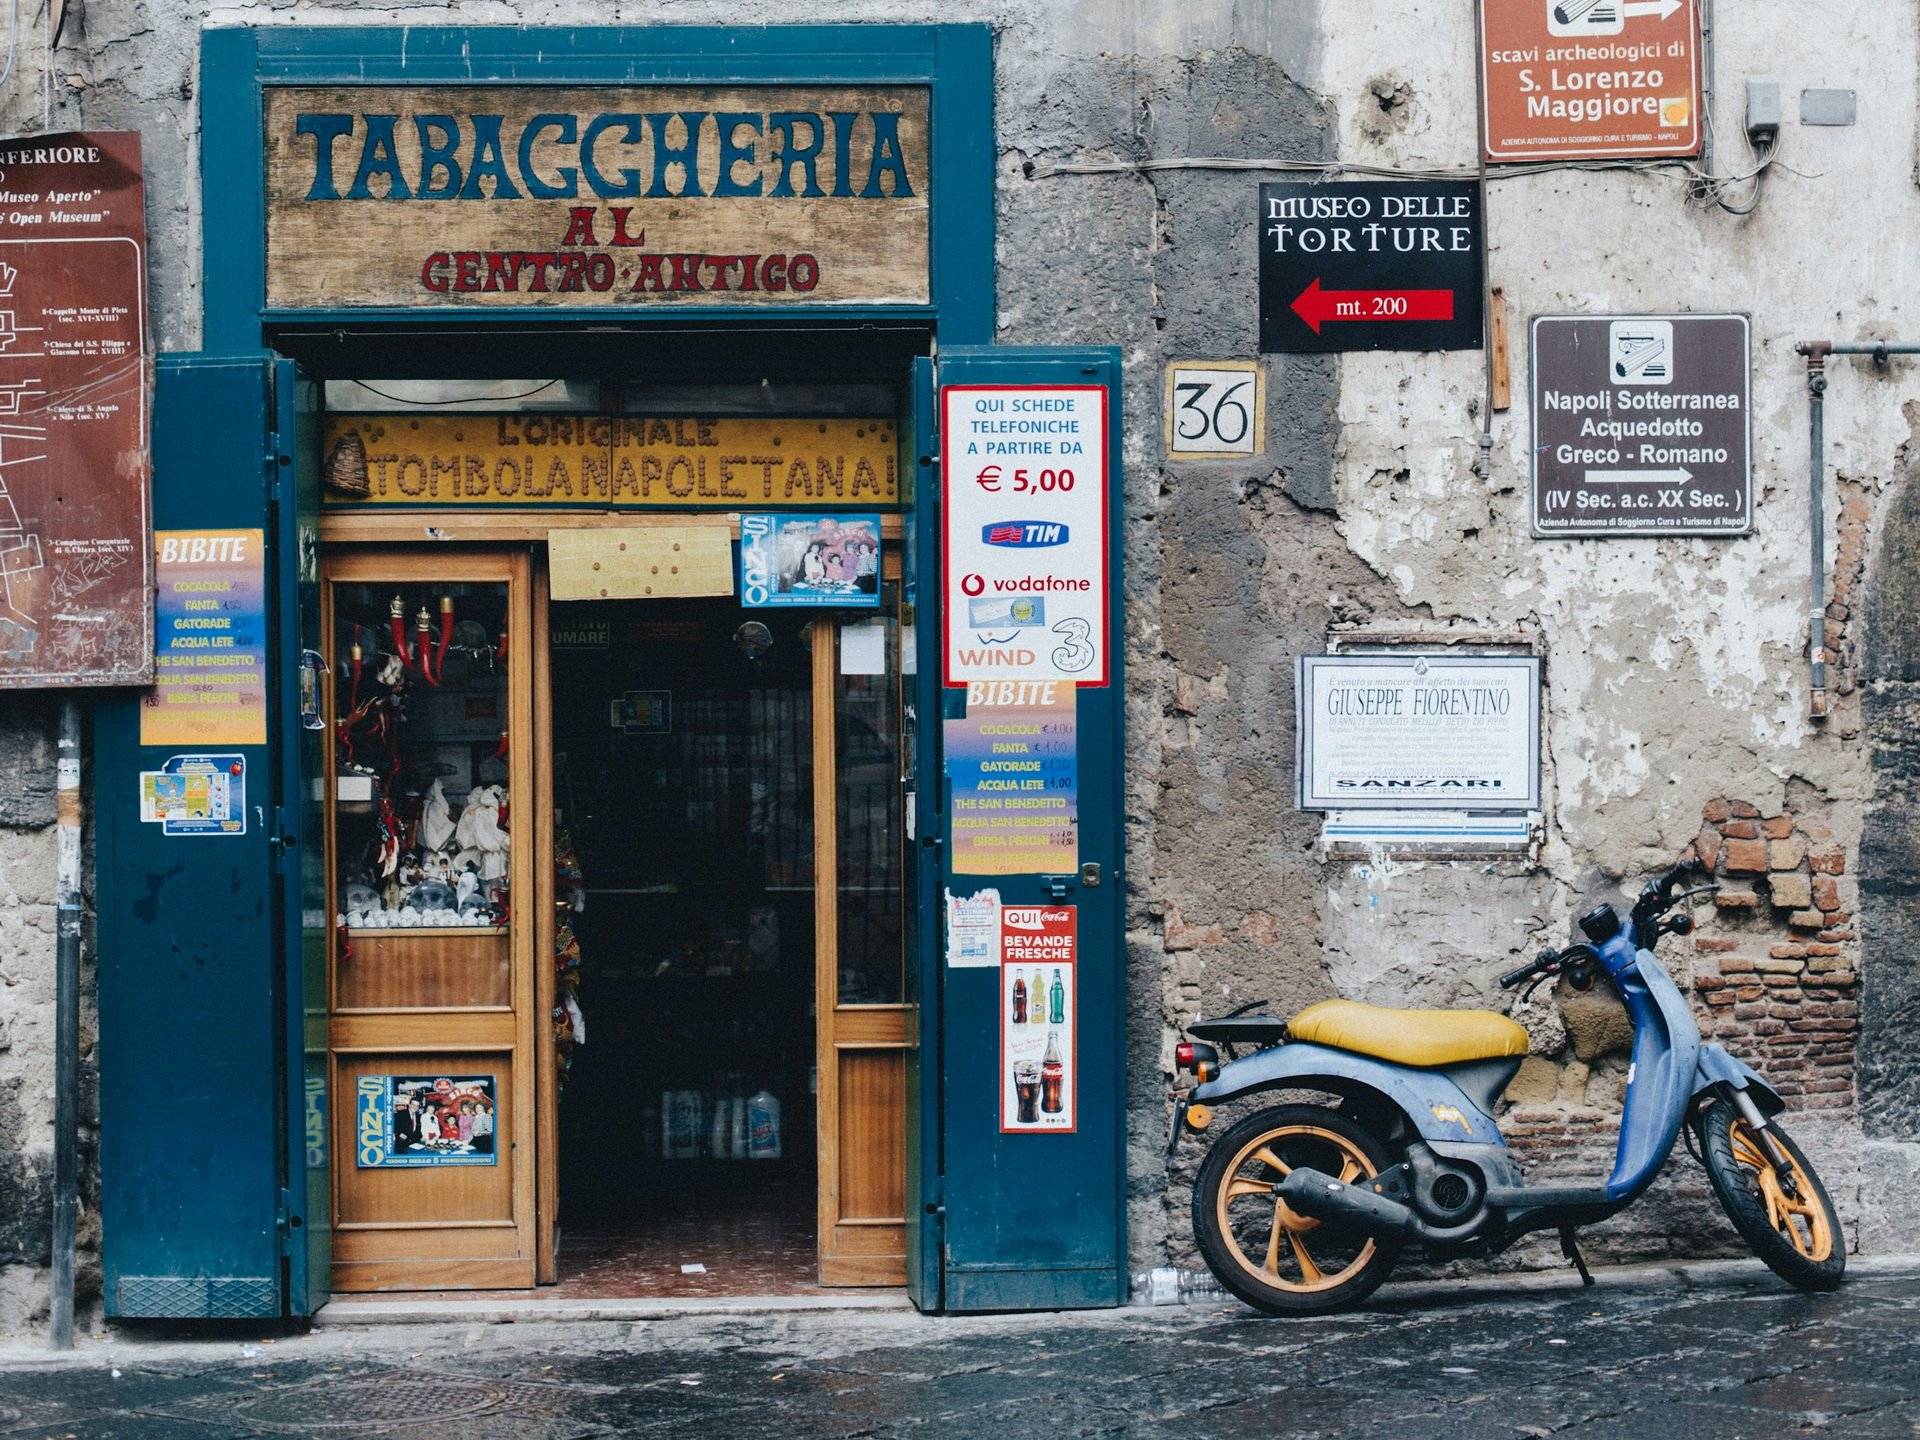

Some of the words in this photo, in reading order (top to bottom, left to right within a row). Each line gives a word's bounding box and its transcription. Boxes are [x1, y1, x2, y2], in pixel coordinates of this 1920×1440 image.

[1492, 46, 1539, 63] scavi
[1545, 42, 1661, 62] archeologici
[1667, 41, 1685, 57] di
[1519, 69, 1541, 92] S.
[1552, 68, 1664, 91] Lorenzo
[1527, 93, 1659, 122] Maggiore
[1268, 197, 1371, 219] MUSEO
[1381, 196, 1470, 218] DELLE
[9, 212, 42, 226] Open
[562, 207, 645, 247] AL
[1268, 223, 1471, 253] TORTURE
[1336, 298, 1367, 316] mt.
[1372, 297, 1407, 316] 200
[975, 399, 1005, 413] QUI
[1012, 399, 1075, 412] SCHEDE
[1544, 391, 1611, 414] Napoli
[1617, 391, 1739, 410] Sotterranea
[1175, 381, 1252, 444] 36
[971, 420, 1080, 433] TELEFONICHE
[1580, 418, 1703, 441] Acquedotto
[967, 441, 978, 454] A
[986, 441, 1053, 454] PARTIRE
[1060, 441, 1083, 454] DA
[1556, 445, 1620, 464] Greco
[1639, 444, 1728, 464] Romano
[367, 454, 573, 497] TOMBOLA
[1013, 468, 1075, 495] 5,00
[1545, 490, 1570, 512] (IV
[1576, 490, 1616, 508] Sec.
[1621, 494, 1653, 508] a.c.
[1657, 490, 1684, 507] XX
[1539, 519, 1568, 527] Azienda
[1570, 518, 1607, 526] Autonoma
[1609, 518, 1616, 526] di
[1617, 518, 1655, 528] Soggiorno
[1657, 518, 1674, 526] Cura
[1682, 518, 1712, 526] Turismo
[1722, 518, 1745, 526] Napoli
[1026, 525, 1062, 543] TIM
[161, 536, 248, 564] BIBITE
[993, 575, 1091, 592] vodafone
[185, 600, 219, 610] FANTA
[174, 618, 231, 629] GATORADE
[171, 637, 209, 648] ACQUA
[211, 637, 234, 648] LETE
[156, 656, 171, 667] HE
[172, 656, 193, 666] SAN
[196, 655, 256, 666] BENEDETTO
[958, 649, 1036, 666] WIND
[967, 681, 1059, 706] BIBITE
[1328, 688, 1403, 716] GIUSEPPE
[1413, 688, 1510, 716] FIORENTINO
[992, 742, 1029, 753] FANTA
[980, 761, 1041, 772] GATORADE
[977, 780, 1019, 791] ACQUA
[1020, 780, 1044, 790] LETE
[1336, 780, 1502, 788] SANZARI
[955, 799, 976, 810] THE
[978, 799, 1001, 810] SAN
[1005, 798, 1066, 809] BENEDETTO
[1009, 912, 1036, 924] QUI
[1004, 935, 1073, 947] BEVANDE
[1006, 948, 1071, 959] FRESCHE
[358, 1077, 385, 1165] SINCO
